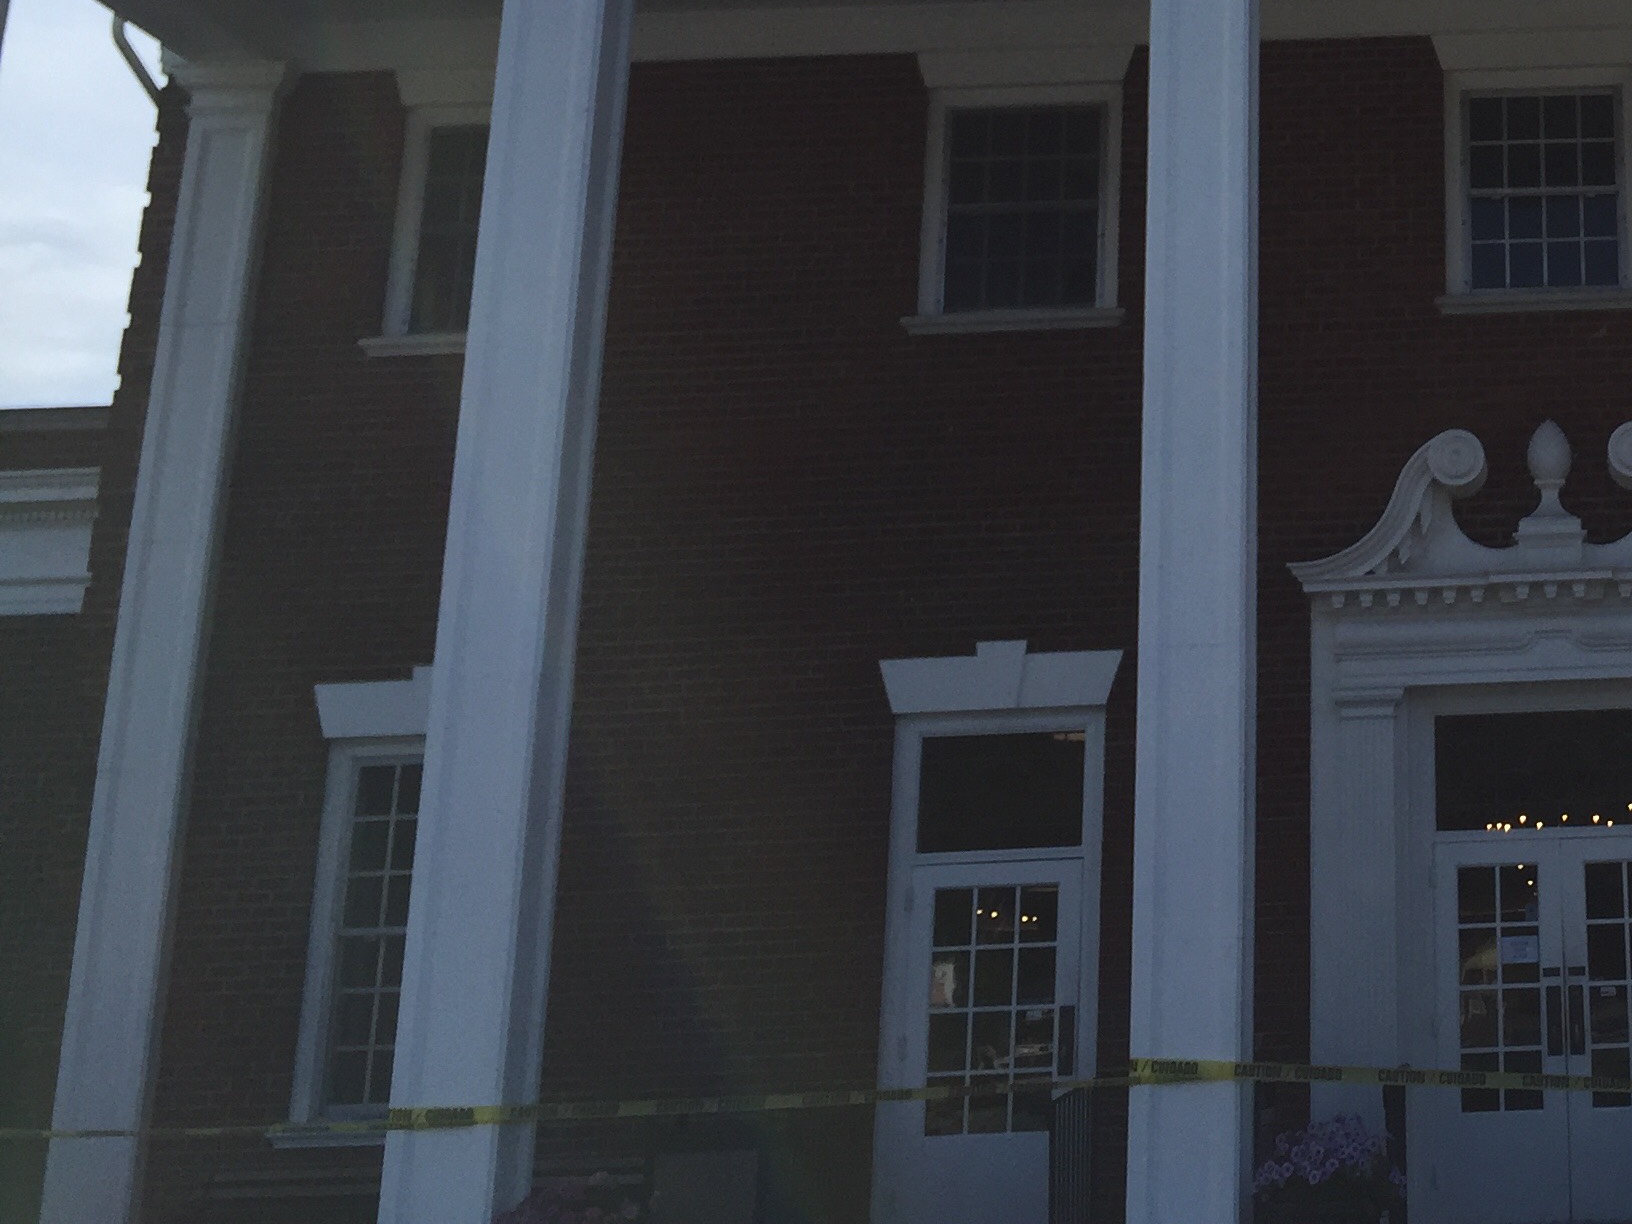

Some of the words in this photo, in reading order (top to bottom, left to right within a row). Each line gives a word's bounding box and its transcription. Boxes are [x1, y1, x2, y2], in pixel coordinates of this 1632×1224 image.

[1151, 1060, 1199, 1074] CUIDADO
[1234, 1064, 1282, 1078] CAUTION
[1294, 1065, 1342, 1080] CUIDADO
[1378, 1069, 1425, 1084] CAUTION
[1439, 1071, 1486, 1085] CUIDADO
[1522, 1075, 1569, 1088] CAUTION
[1584, 1076, 1631, 1089] CUIDADO
